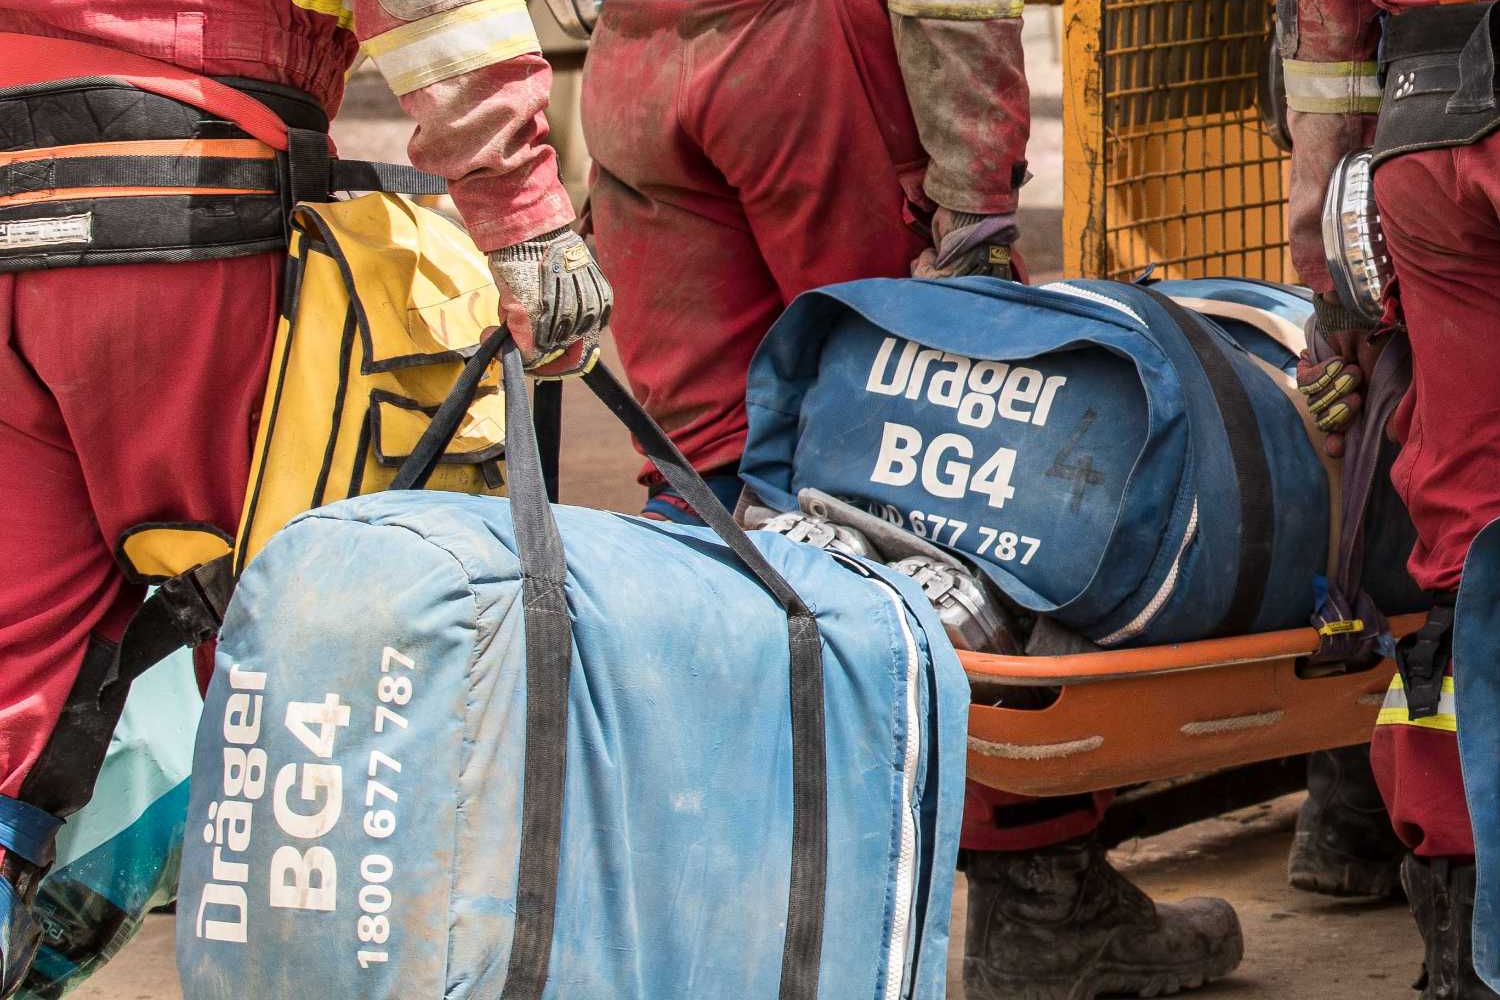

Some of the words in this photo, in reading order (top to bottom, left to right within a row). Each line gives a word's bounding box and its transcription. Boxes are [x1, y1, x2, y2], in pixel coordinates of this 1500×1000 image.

[870, 421, 1018, 509] BG4
[1045, 408, 1103, 513] 4
[908, 510, 968, 549] 677
[978, 526, 1041, 566] 787
[373, 645, 416, 734] 787
[196, 663, 268, 944] Dräger
[269, 692, 352, 912] BG4
[362, 750, 403, 839] 677
[356, 853, 395, 970] 1800
